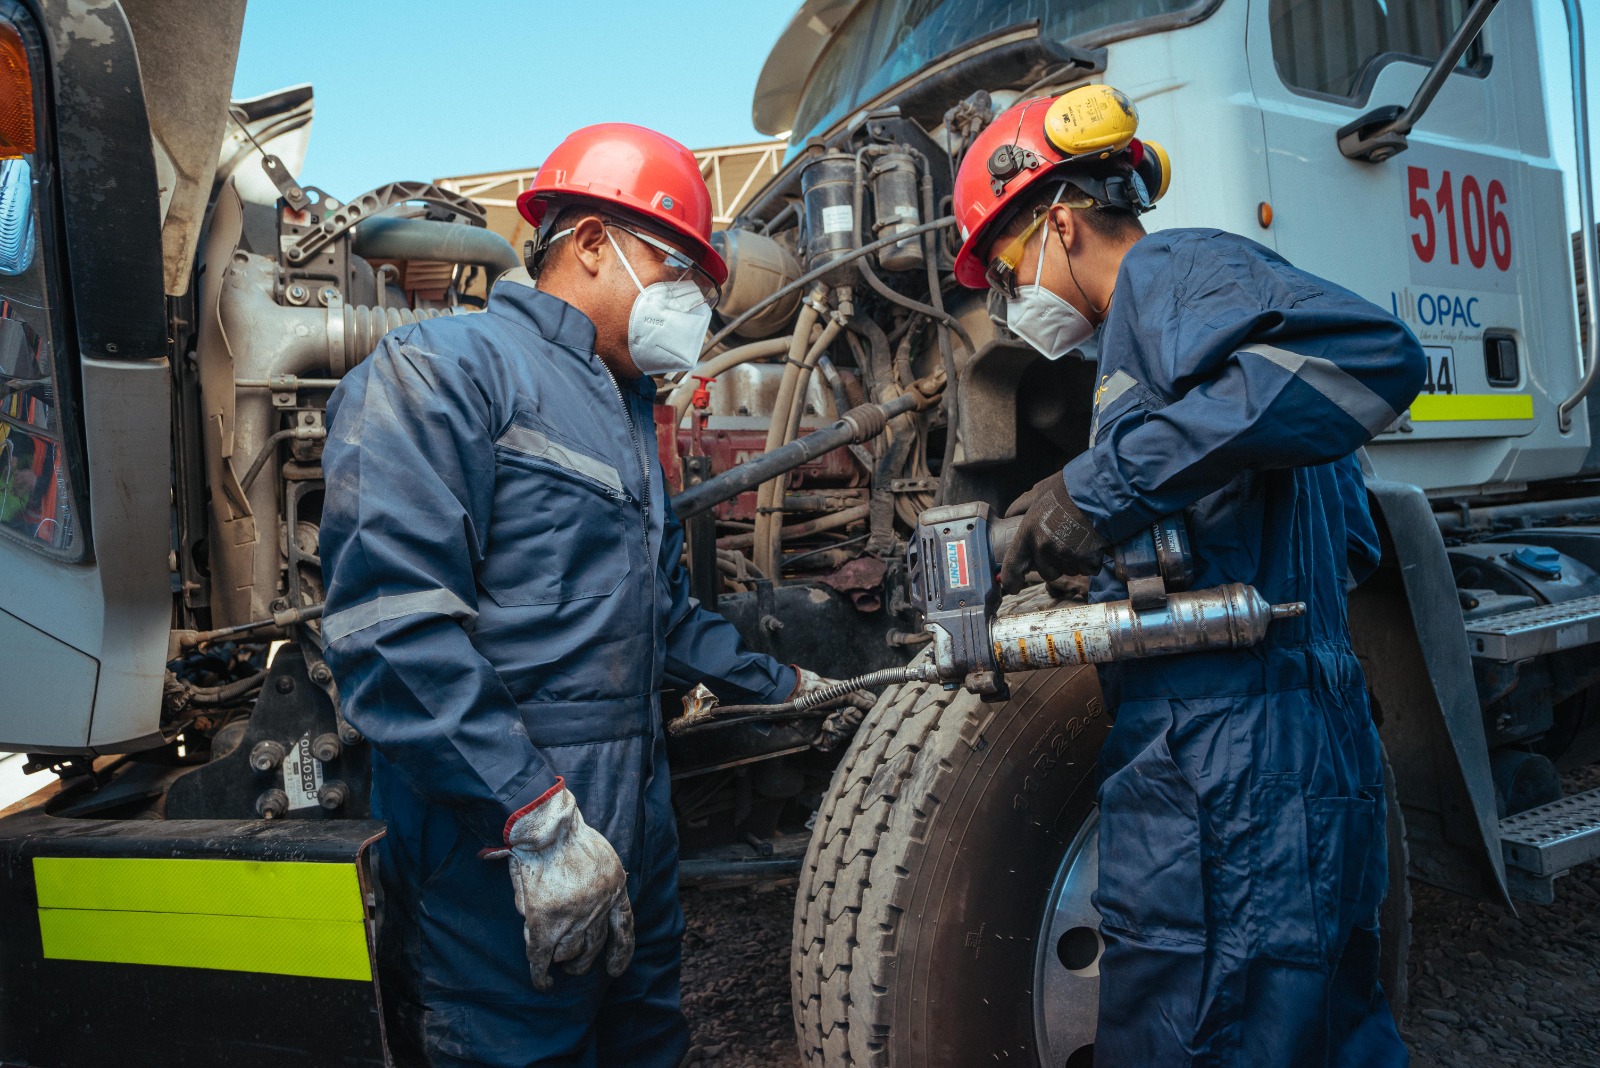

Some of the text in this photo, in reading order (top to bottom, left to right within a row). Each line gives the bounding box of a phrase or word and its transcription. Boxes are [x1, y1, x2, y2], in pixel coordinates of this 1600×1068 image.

[1407, 165, 1512, 272] 5106
[643, 317, 665, 327] KN95
[1153, 521, 1164, 551] LITHIU
[948, 543, 960, 585] LINCOLN
[1013, 697, 1102, 810] 11R22.5
